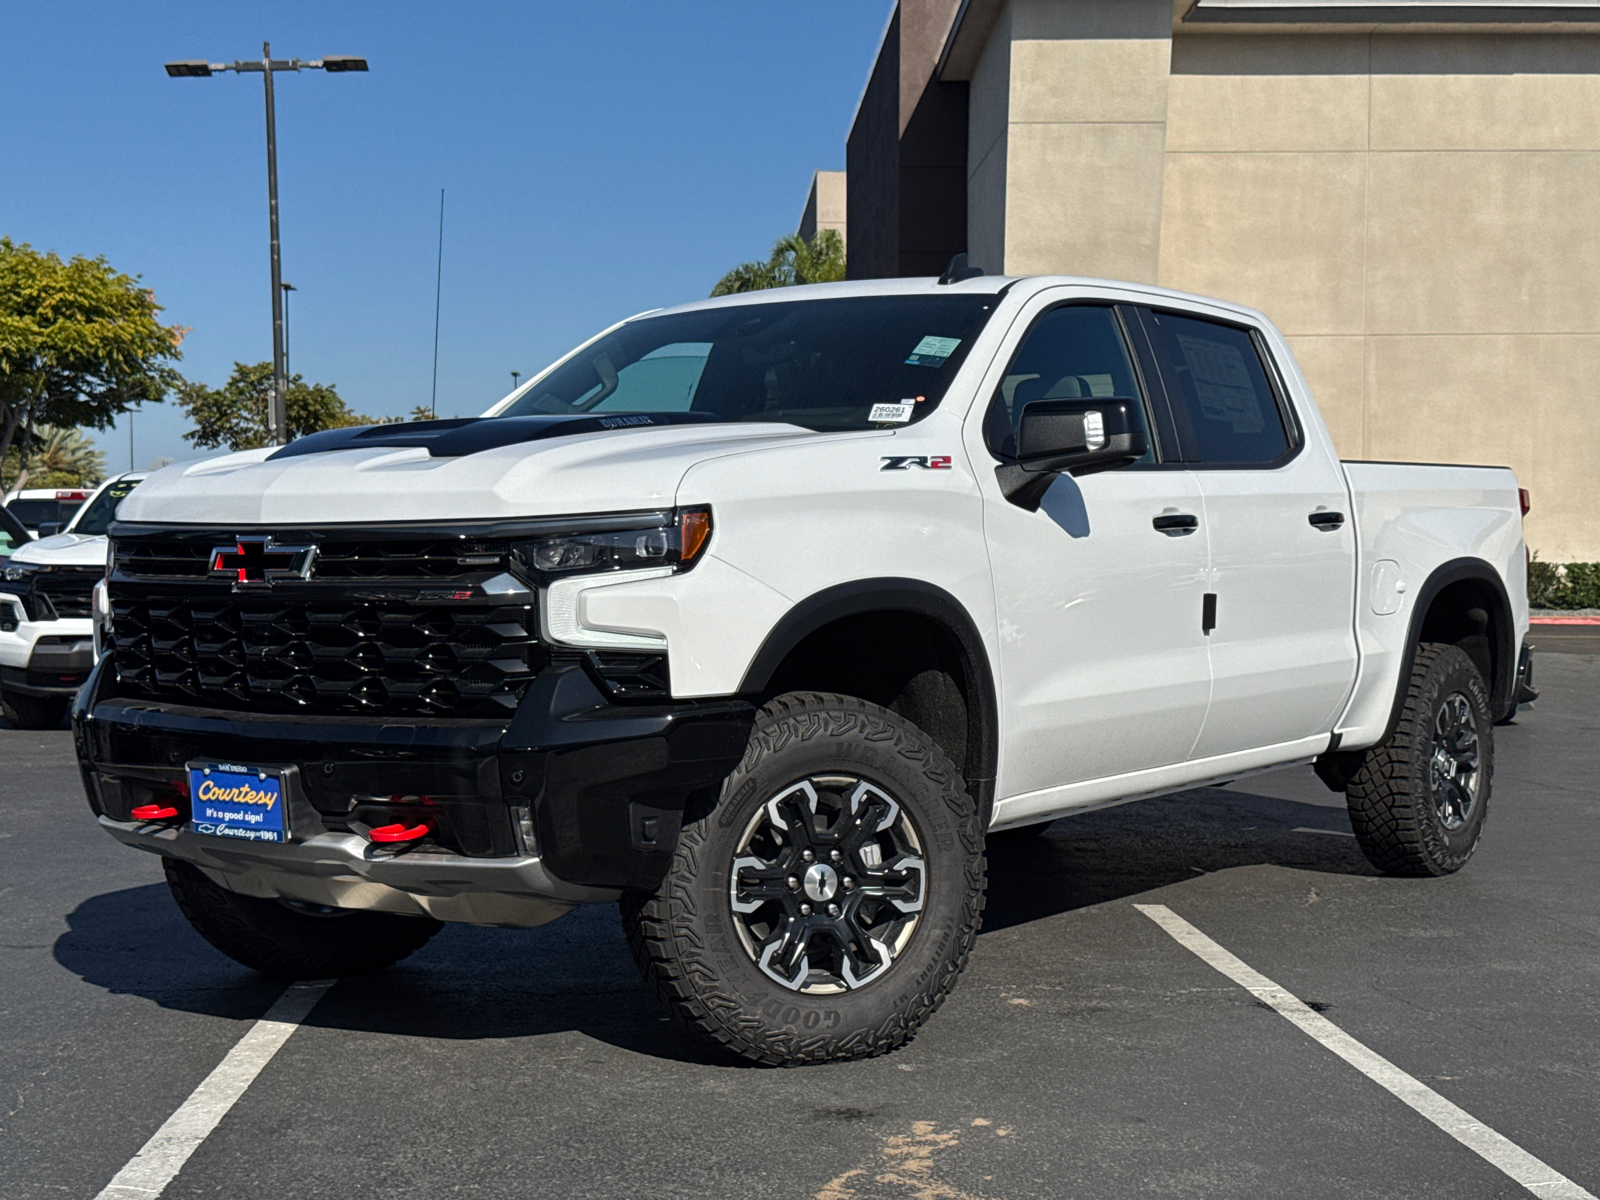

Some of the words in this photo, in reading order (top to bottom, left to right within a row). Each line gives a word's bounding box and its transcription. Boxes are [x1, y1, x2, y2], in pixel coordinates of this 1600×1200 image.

[880, 456, 952, 471] ZR2
[230, 764, 248, 773] DIEGO
[198, 780, 278, 811] Courtesy
[720, 779, 755, 824] DURAWALL
[834, 742, 956, 853] WRANGLER
[206, 807, 217, 818] It's
[224, 811, 243, 821] good
[245, 811, 263, 824] sign!
[216, 823, 257, 841] Courtesy
